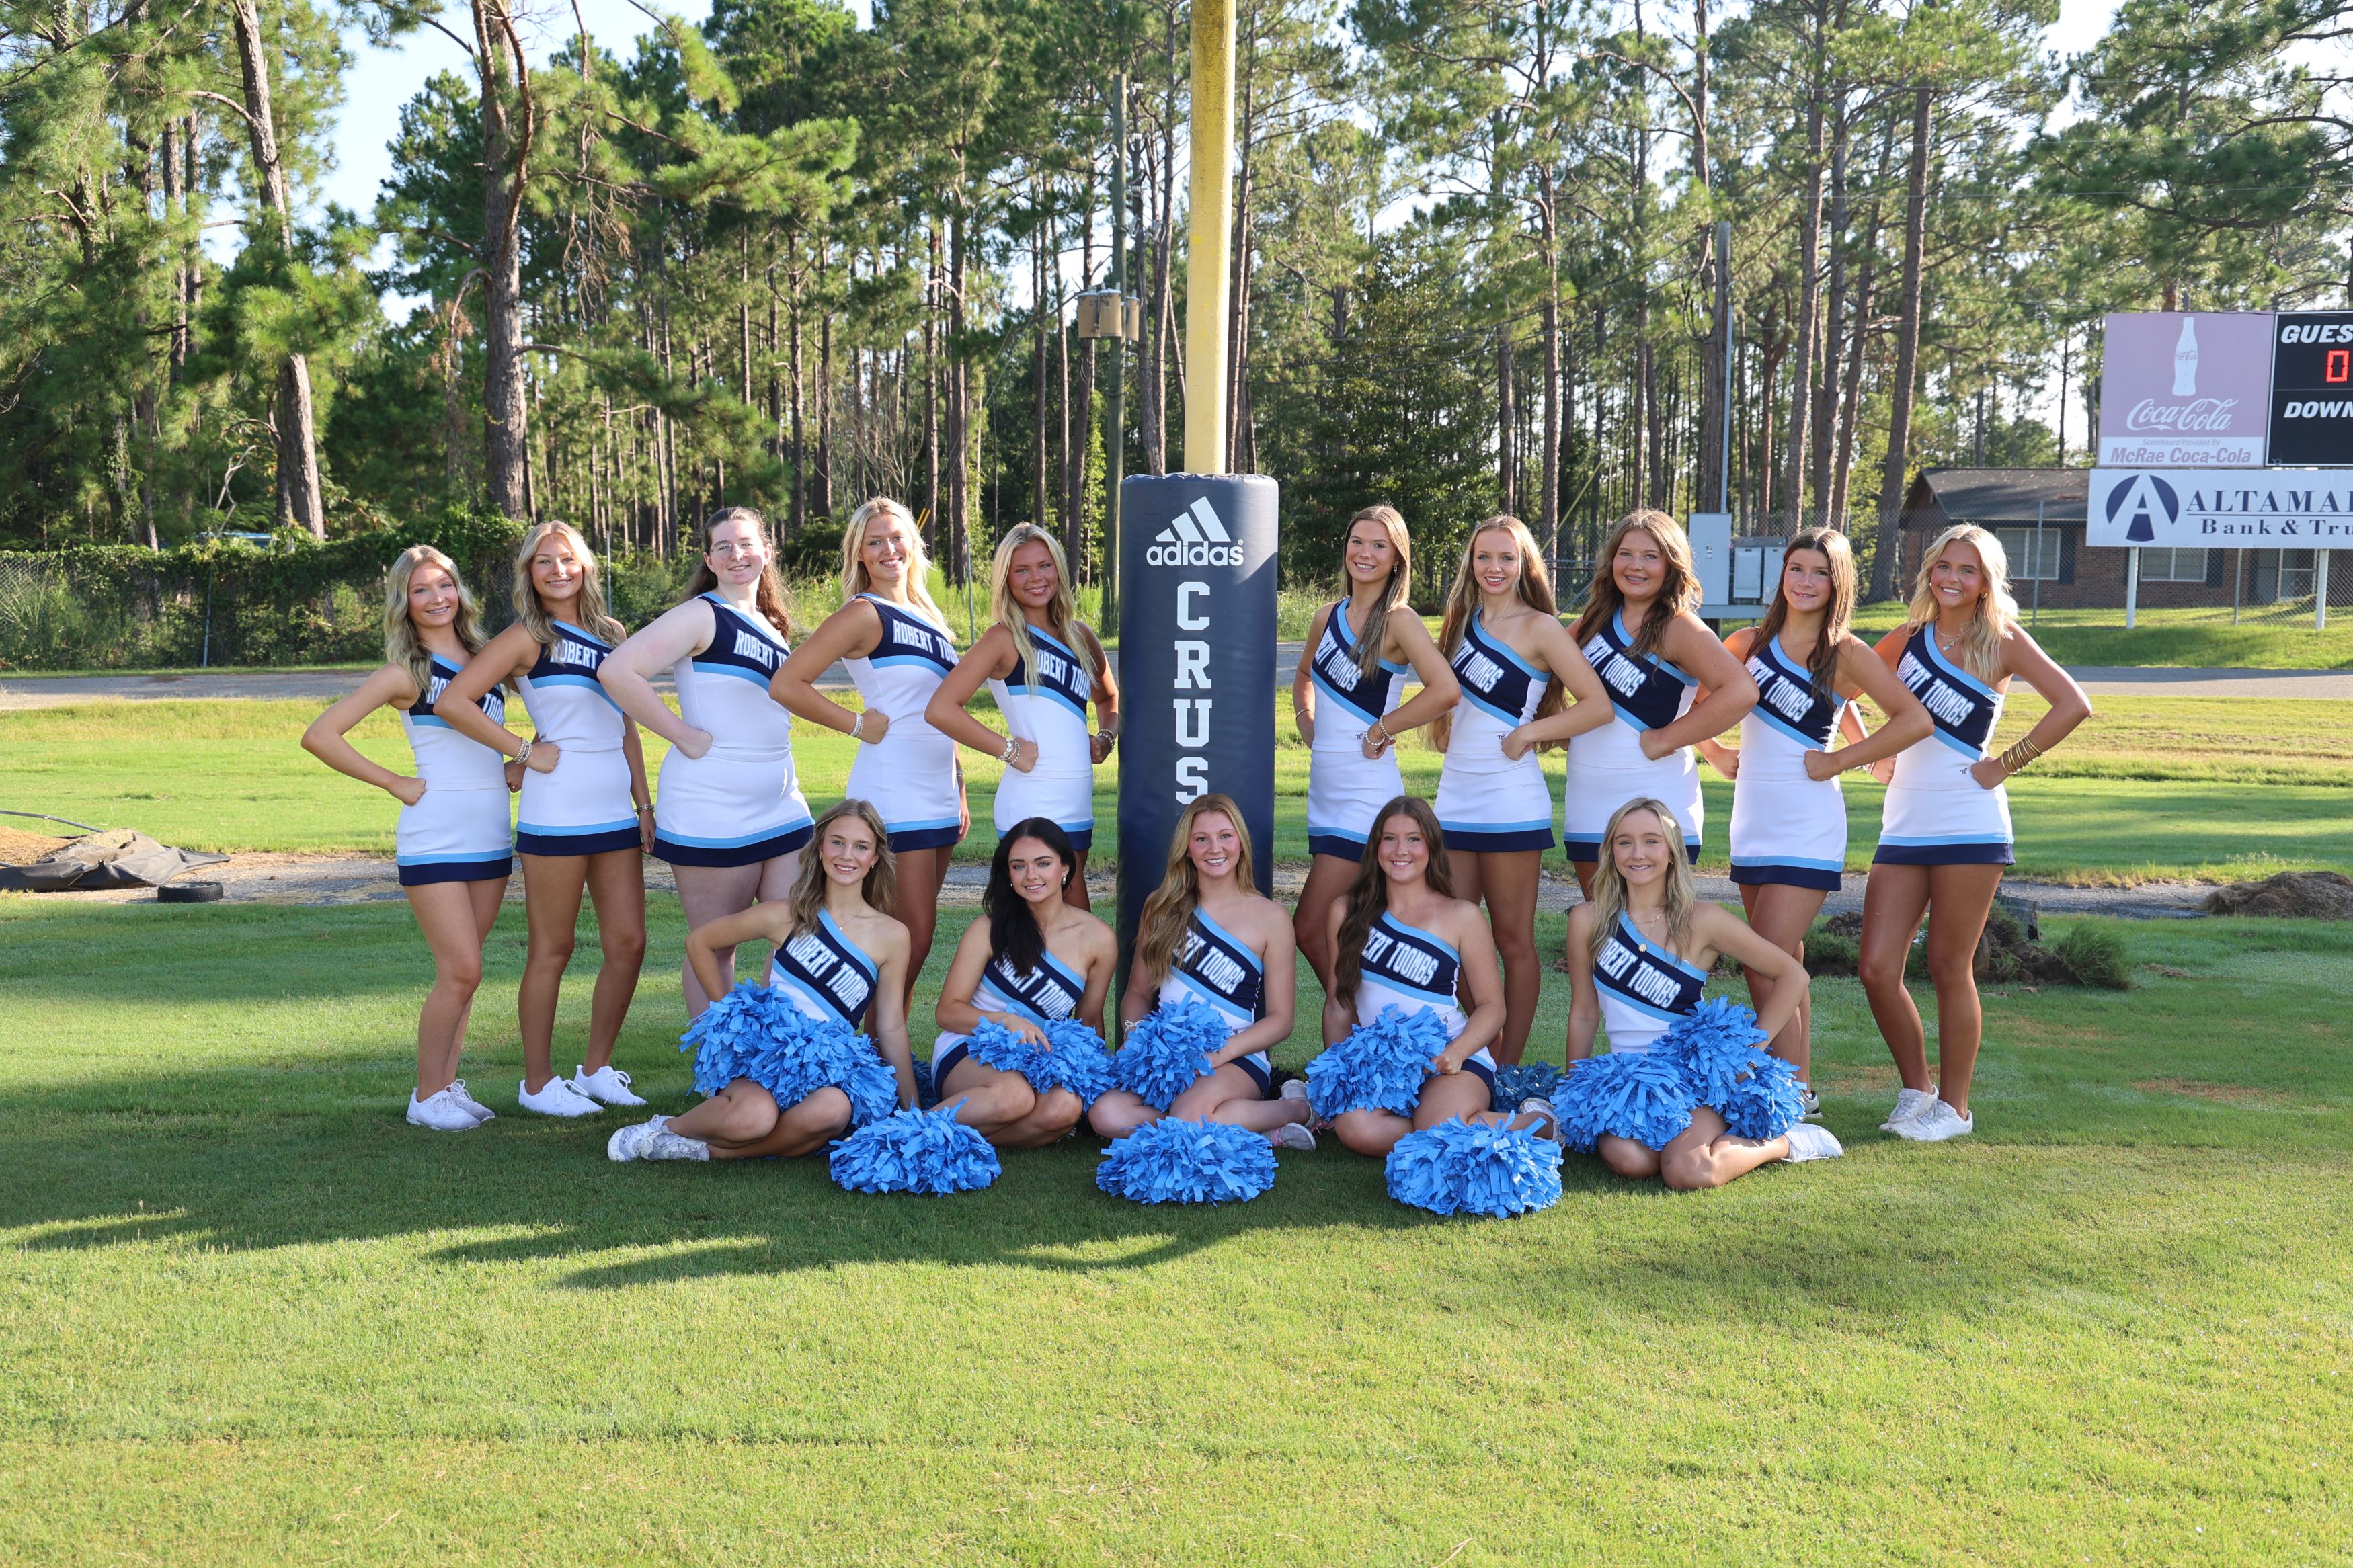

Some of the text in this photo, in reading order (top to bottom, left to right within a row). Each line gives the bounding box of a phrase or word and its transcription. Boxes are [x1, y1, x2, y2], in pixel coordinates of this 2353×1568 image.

[2280, 324, 2353, 344] GUES
[2325, 349, 2350, 382] 0
[2126, 399, 2239, 431] Coca-Cola
[2110, 448, 2251, 463] McRae Coca-Cola
[2211, 439, 2221, 447] By
[2202, 519, 2272, 535] Bank
[2281, 519, 2300, 535] &
[1146, 540, 1244, 566] adidas
[733, 628, 774, 671] ROBERT
[892, 618, 934, 655] ROBERT
[1033, 647, 1068, 686] OBERT
[1324, 647, 1363, 693] TOOMBS
[1461, 653, 1505, 694] TOOMBS
[1600, 652, 1647, 698] TOOMBS
[1763, 674, 1816, 723] TOOMBS
[1921, 677, 1976, 727] TOOMBS
[1195, 945, 1246, 995] TOOMBS
[1385, 940, 1439, 987] TOOMBS
[1596, 936, 1682, 1009] OBERT TOOMBS
